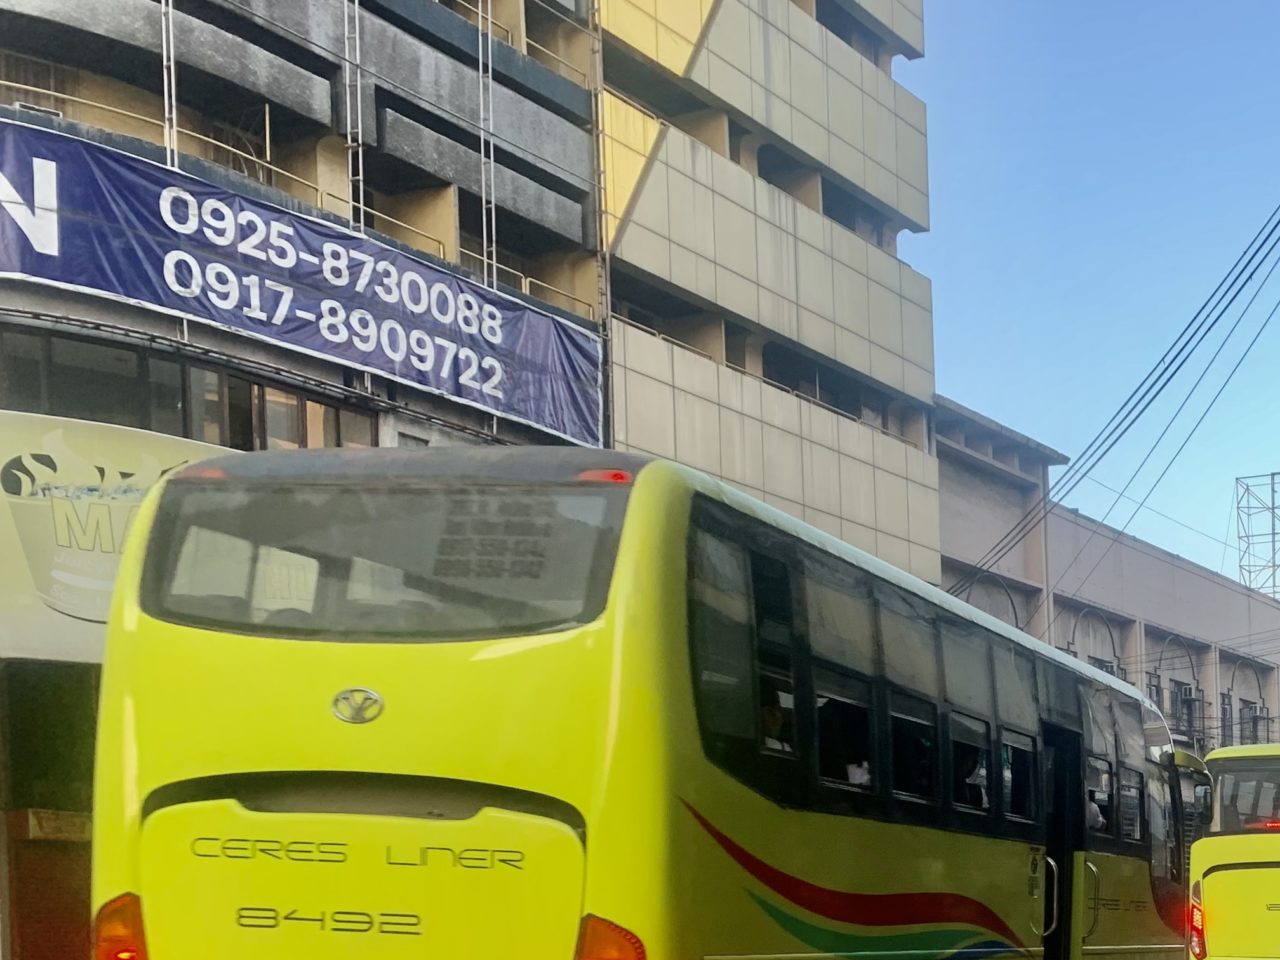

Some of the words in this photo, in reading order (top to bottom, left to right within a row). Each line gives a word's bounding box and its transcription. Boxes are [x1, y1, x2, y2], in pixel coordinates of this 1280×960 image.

[159, 186, 502, 344] 0925-8730088
[163, 250, 503, 399] 0917-8909722
[190, 837, 348, 863] CERES
[385, 845, 525, 870] LINER
[236, 906, 423, 936] 8492
